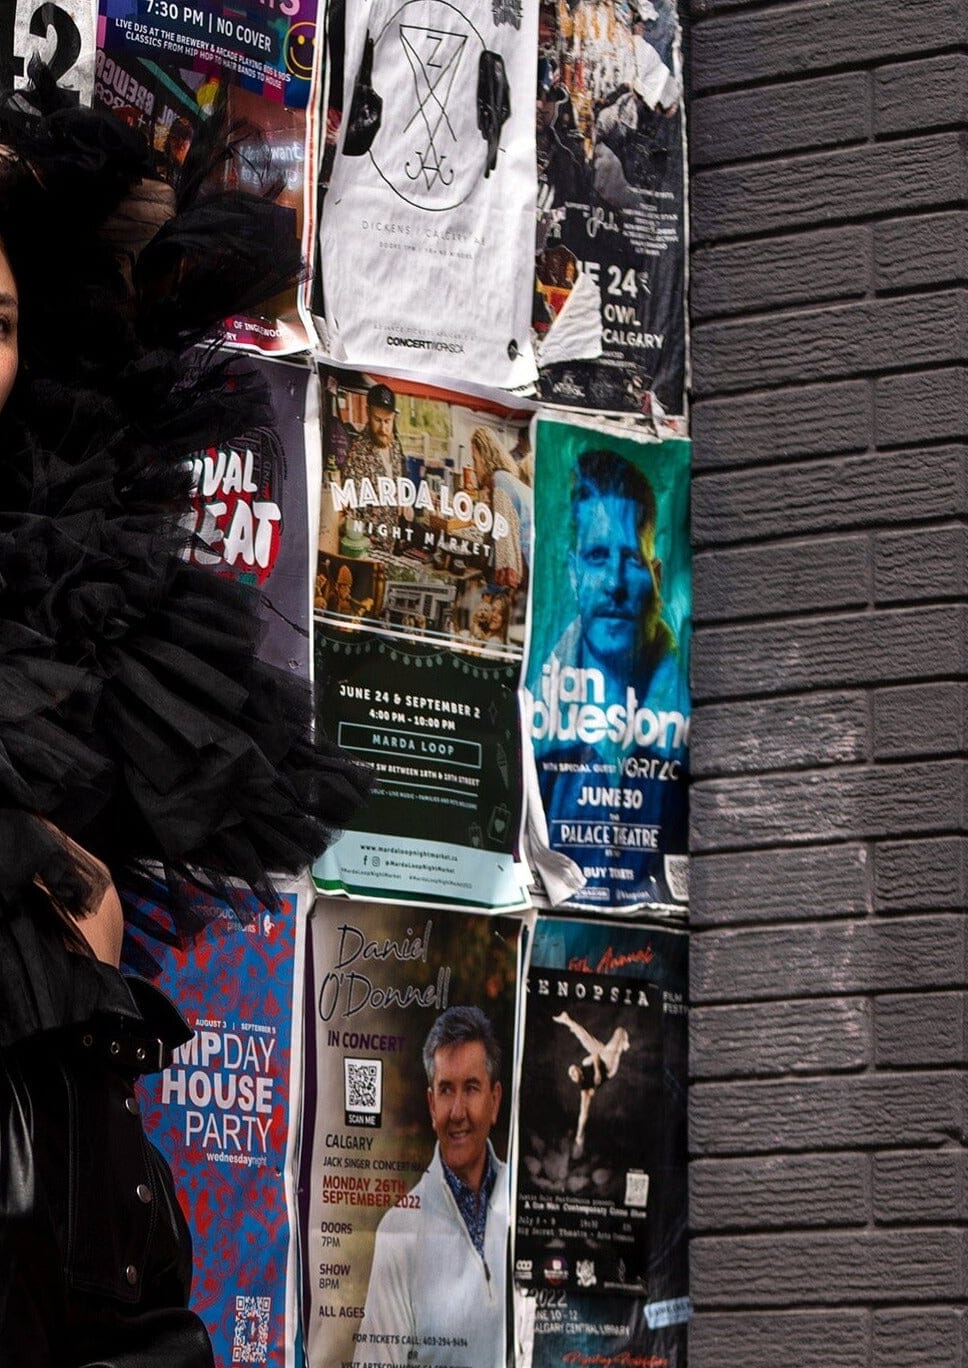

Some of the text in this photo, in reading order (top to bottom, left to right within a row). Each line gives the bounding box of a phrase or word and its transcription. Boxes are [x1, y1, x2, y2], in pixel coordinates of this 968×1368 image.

[146, 0, 272, 53] 7:30 PM NO COVER
[115, 18, 263, 71] LIVE DJS AT THE BREWERY ARCADE PLAYING
[604, 304, 641, 326] OWL
[602, 329, 664, 349] CALGARY
[330, 477, 509, 540] MARDA LOOP
[354, 521, 491, 557] NIGHT MARKET
[372, 734, 455, 756] MARDA LOOP
[577, 786, 643, 809] JUNE 30
[561, 823, 610, 844] PALACE
[334, 920, 432, 969] Daniel
[319, 966, 451, 1021] O'Donnell
[195, 1017, 271, 1034] AUGUST SEPTEMBER
[161, 1068, 274, 1114] HOUSE
[185, 1110, 273, 1153] PARTY
[325, 1134, 374, 1151] CALGARY
[322, 1175, 407, 1194] MONDAY 26TH
[322, 1190, 421, 1210] SEPTEMBER 2022
[320, 1222, 353, 1234] DOORS
[321, 1236, 340, 1248] 7PM
[319, 1264, 351, 1275] SHOW
[319, 1279, 340, 1289] 8PM
[319, 1306, 365, 1318] ALL AGES
